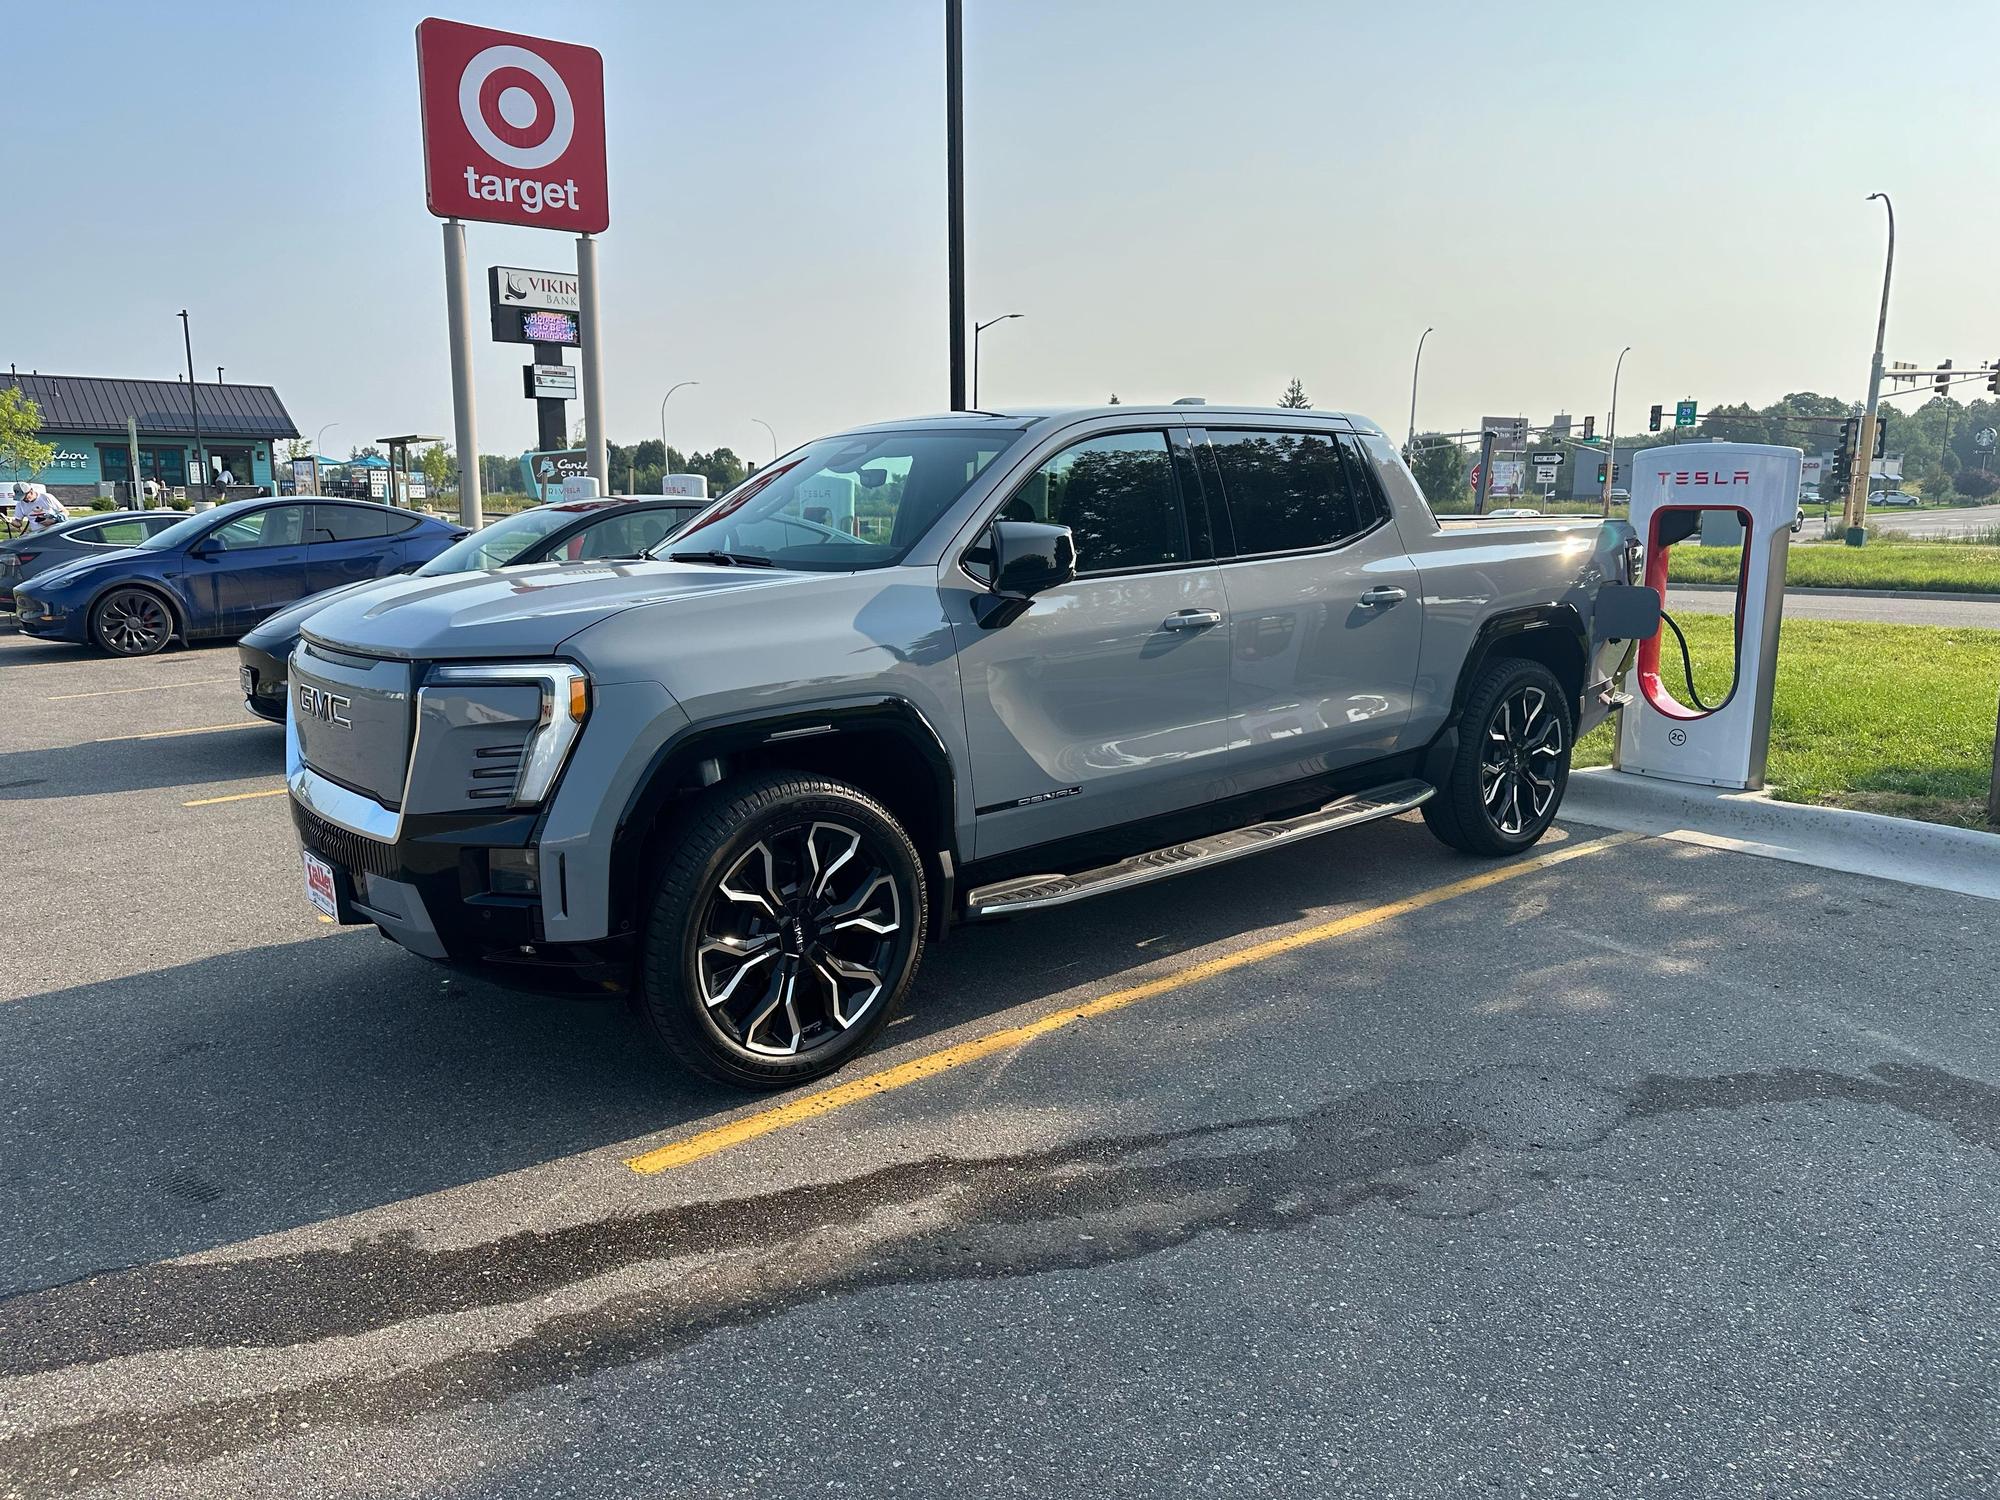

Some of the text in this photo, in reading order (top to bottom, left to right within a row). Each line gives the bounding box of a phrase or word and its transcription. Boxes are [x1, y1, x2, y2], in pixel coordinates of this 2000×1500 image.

[463, 165, 580, 214] target
[528, 277, 577, 295] VIKIN
[546, 294, 577, 306] BANK
[1681, 408, 1691, 416] 29
[557, 458, 588, 470] Cari
[560, 470, 588, 478] COFF
[1657, 471, 1749, 485] TESLA
[665, 486, 687, 494] TESLA
[300, 683, 353, 731] GMC
[1671, 732, 1684, 743] 2C
[1017, 786, 1083, 806] DENALI
